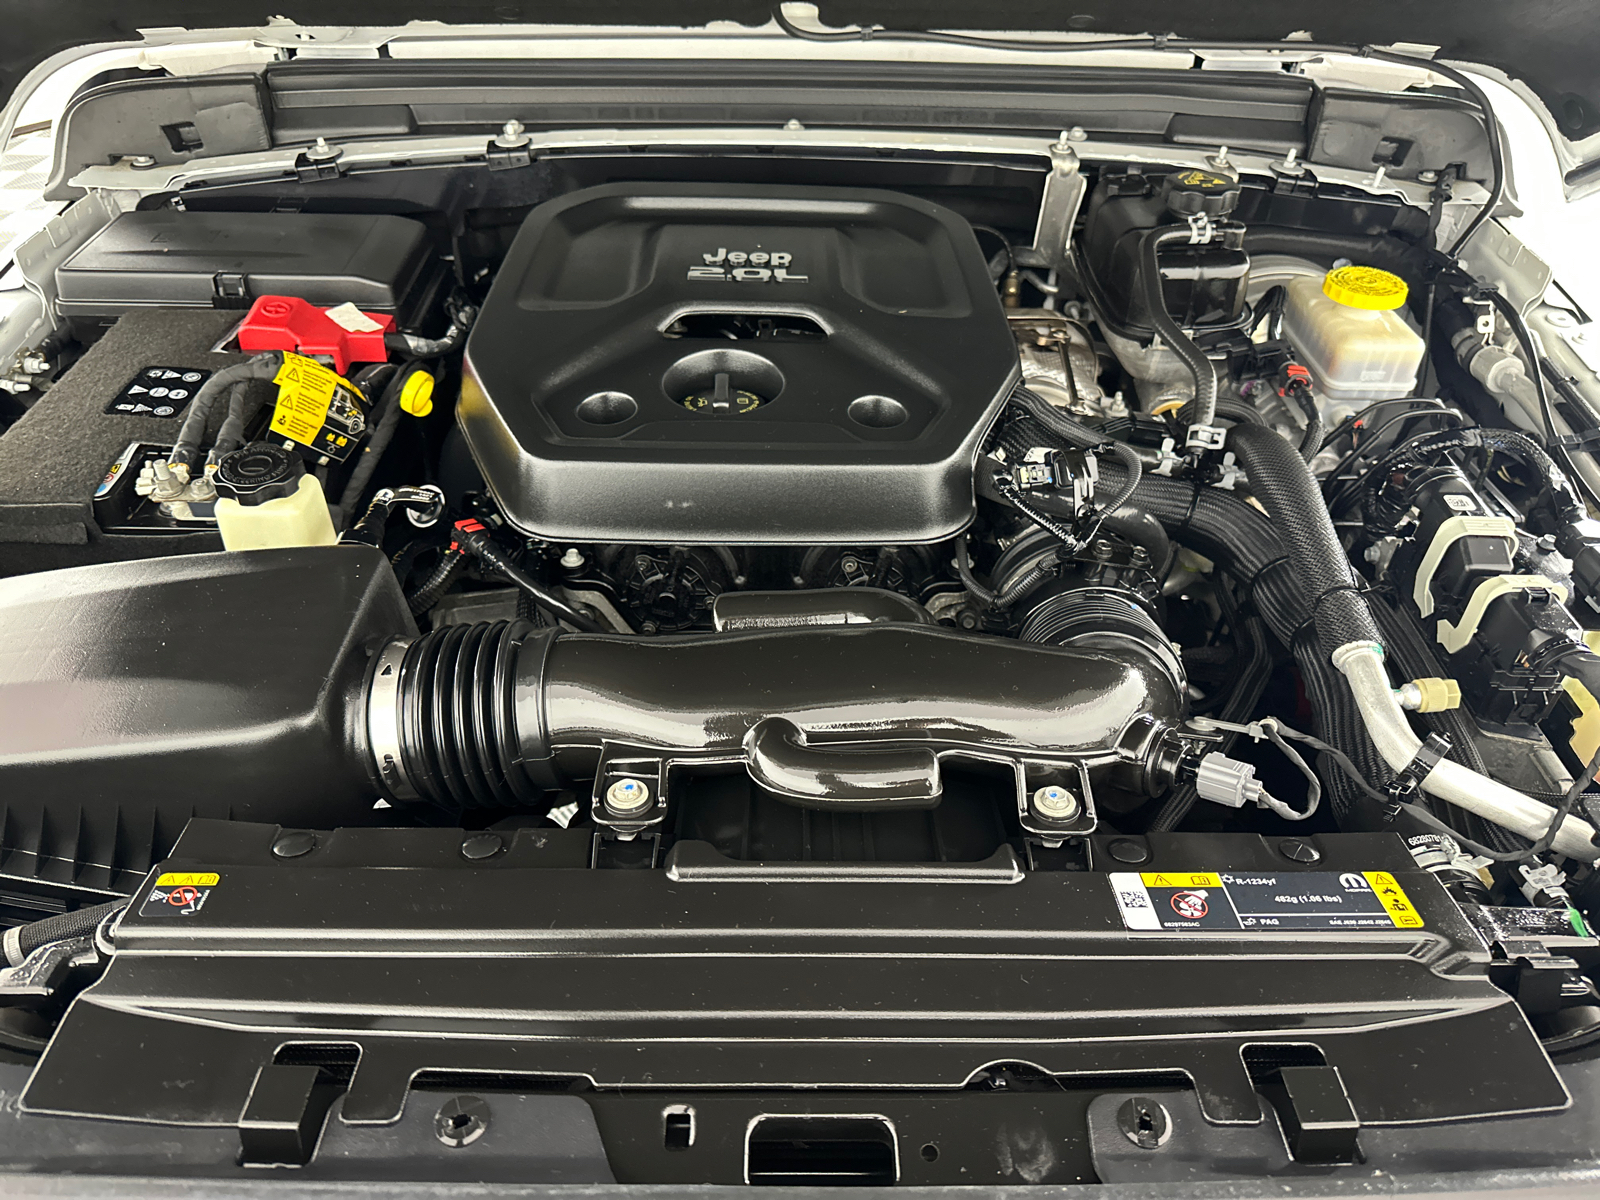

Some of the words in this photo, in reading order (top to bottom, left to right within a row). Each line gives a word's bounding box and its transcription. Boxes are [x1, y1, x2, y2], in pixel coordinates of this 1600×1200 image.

[702, 247, 792, 267] Jeep
[687, 266, 809, 283] 2.0L
[1259, 918, 1280, 926] PAG
